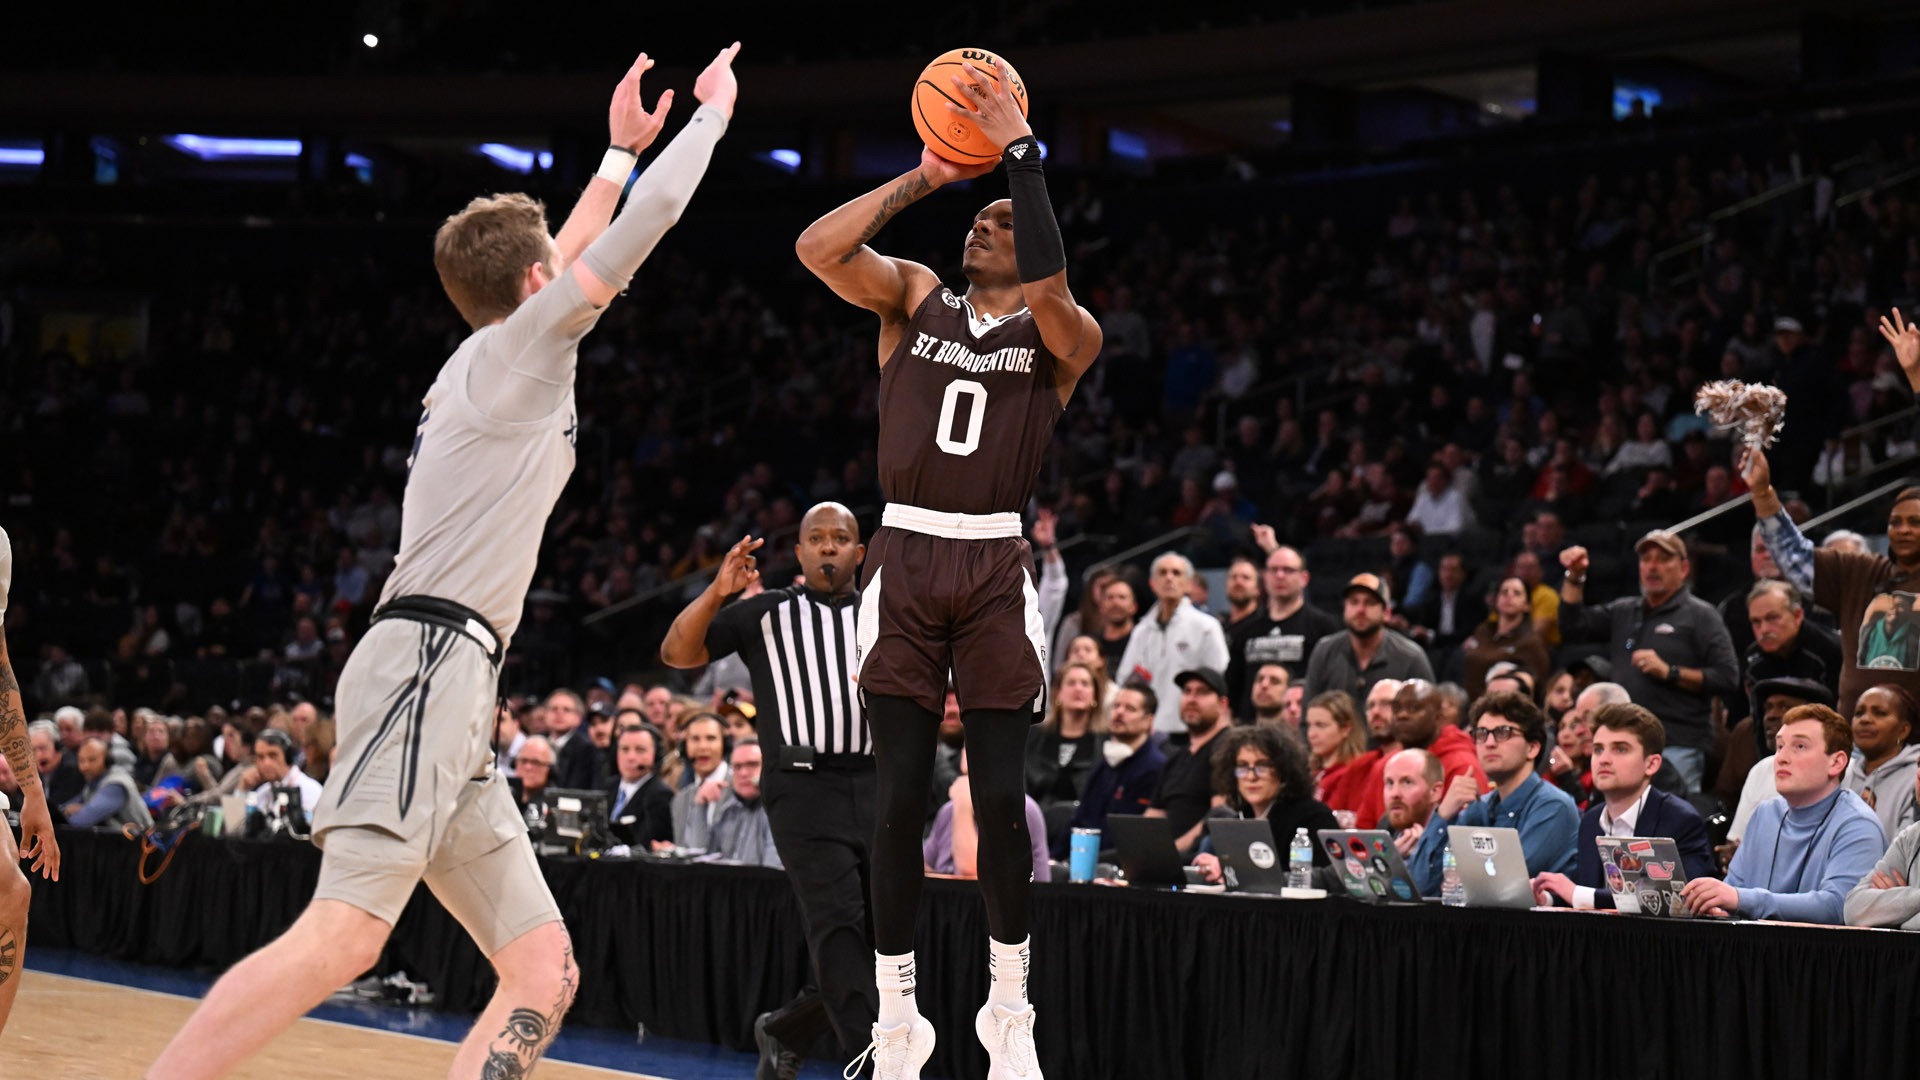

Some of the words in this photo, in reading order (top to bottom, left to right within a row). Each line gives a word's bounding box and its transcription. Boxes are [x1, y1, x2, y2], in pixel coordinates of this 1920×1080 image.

[962, 51, 1025, 99] Wion
[911, 332, 938, 359] ST.
[933, 341, 1035, 373] BONAVENTURE
[935, 378, 988, 457] 0
